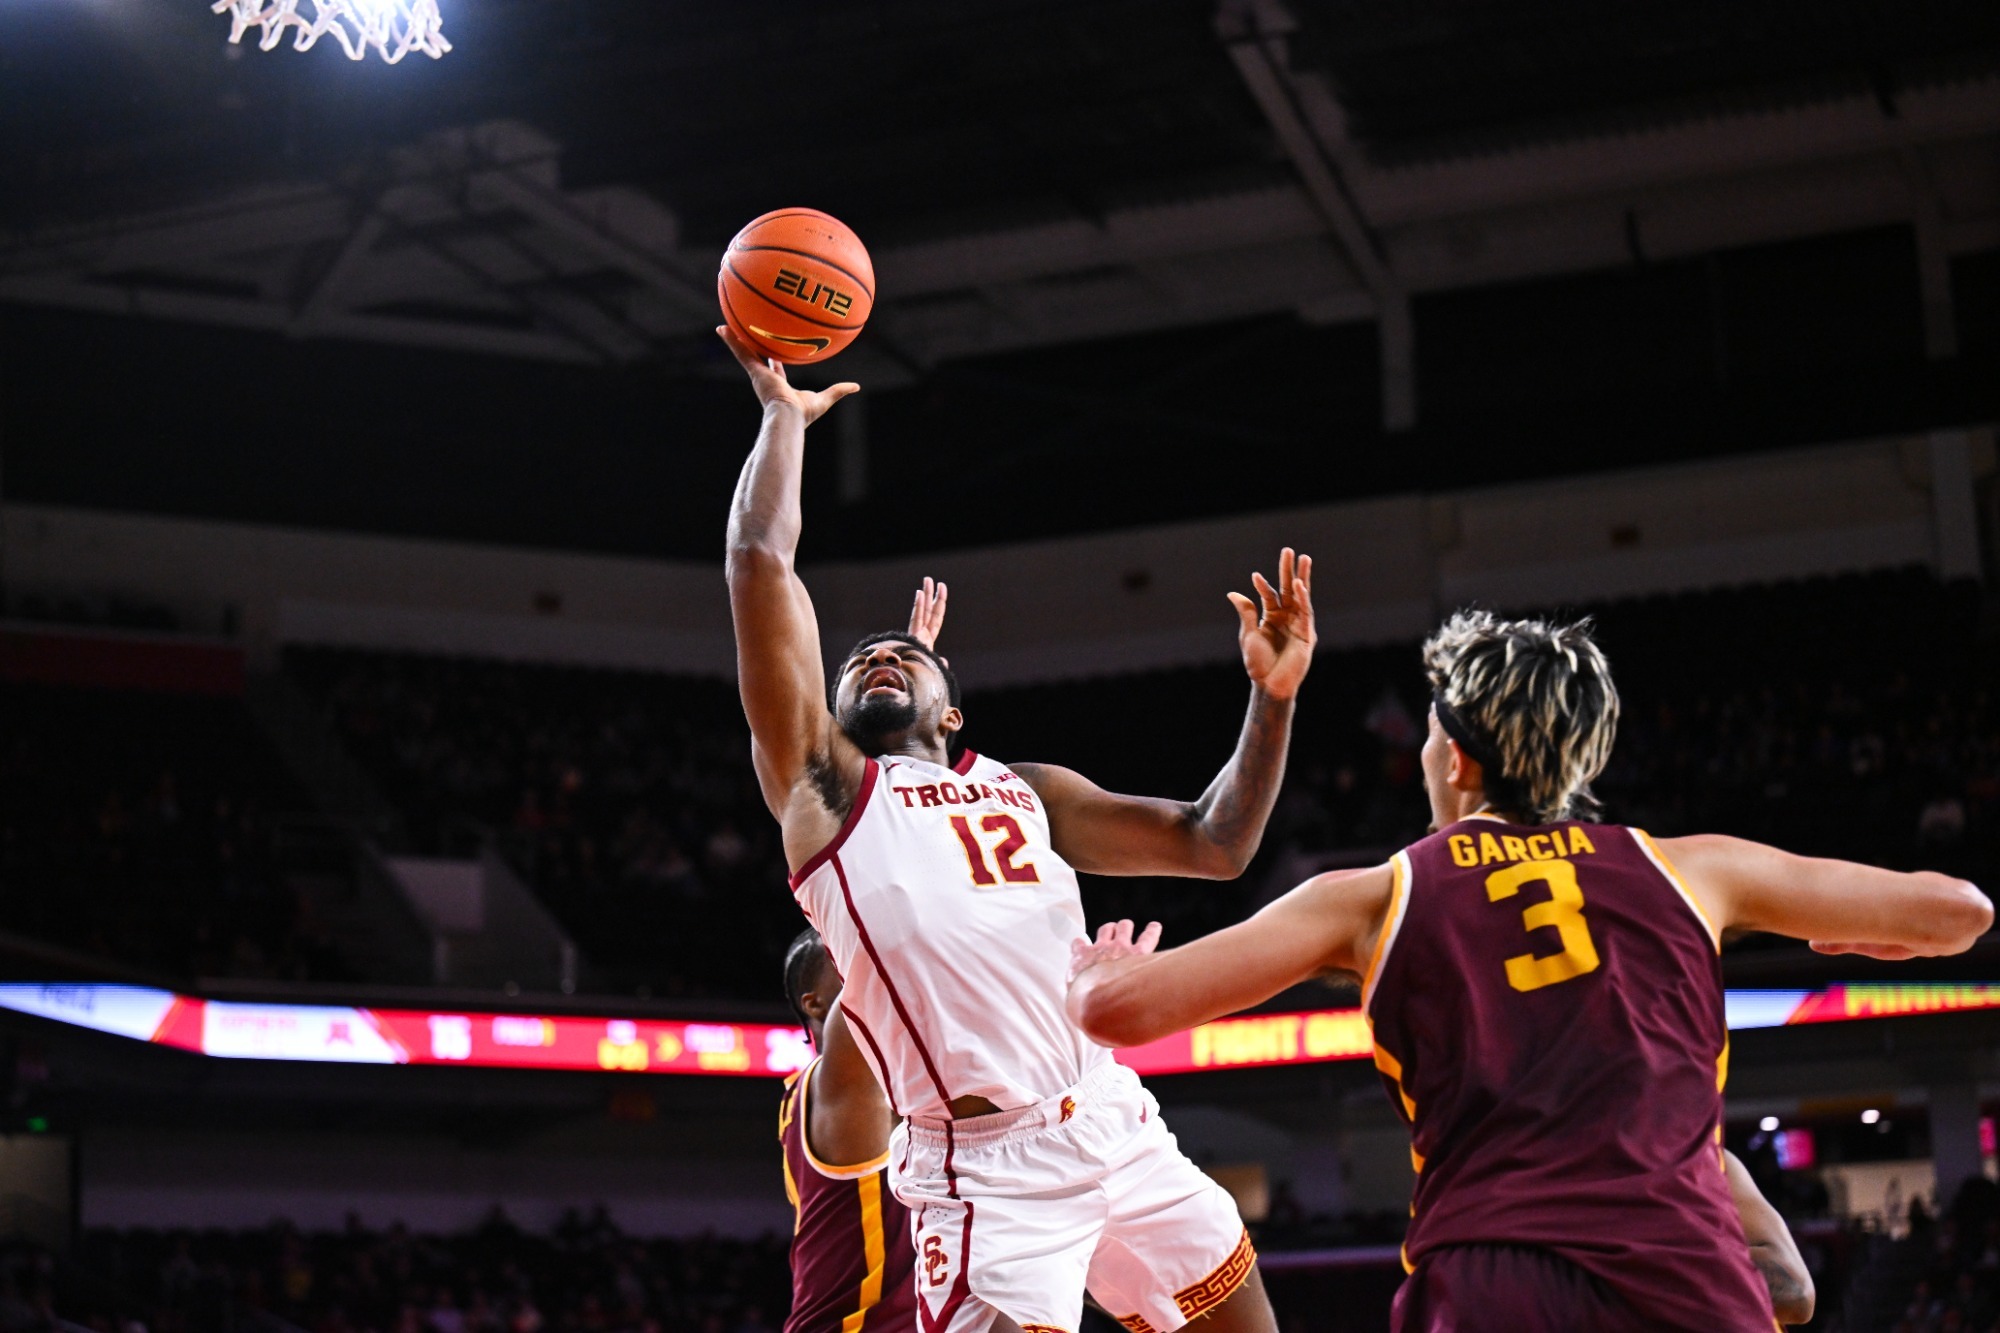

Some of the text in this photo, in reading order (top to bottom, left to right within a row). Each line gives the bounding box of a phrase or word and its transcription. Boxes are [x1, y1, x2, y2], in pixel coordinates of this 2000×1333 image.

[773, 268, 852, 319] ELITE
[893, 781, 1036, 815] TROJANS
[948, 812, 1041, 887] 12
[1448, 826, 1596, 867] GARCIA
[1485, 858, 1600, 992] 3
